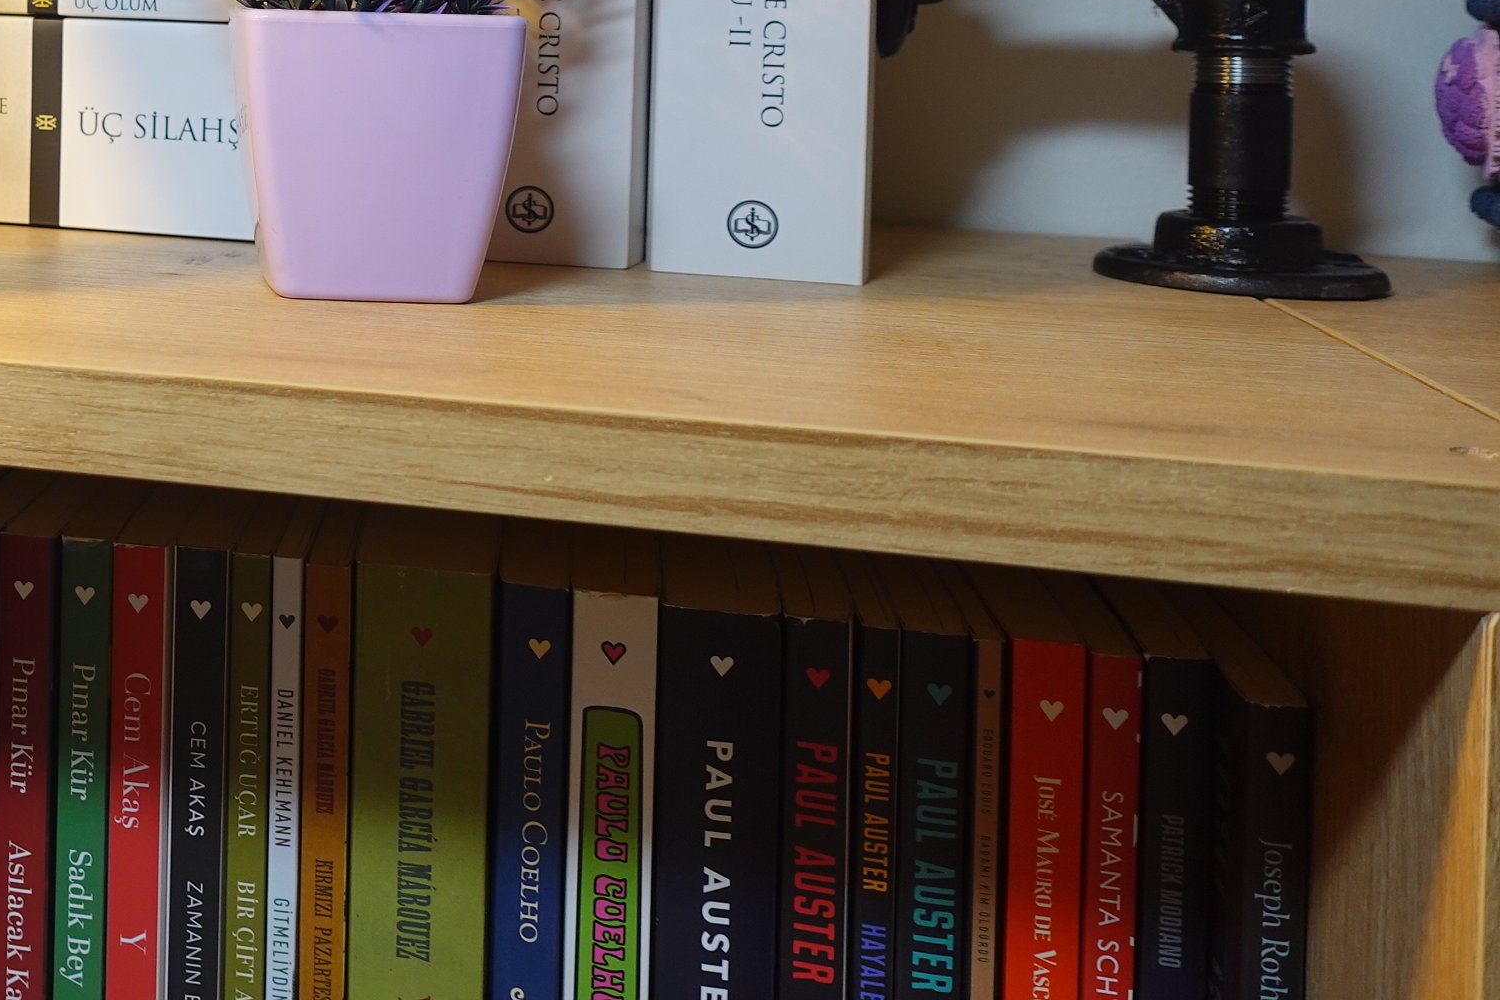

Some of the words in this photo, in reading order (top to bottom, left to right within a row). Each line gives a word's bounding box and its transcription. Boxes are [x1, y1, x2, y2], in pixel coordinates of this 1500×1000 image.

[536, 12, 562, 116] CRISTO
[760, 20, 788, 128] CRISTO
[78, 106, 123, 144] ÜÇ
[10, 656, 36, 737] Pınar
[69, 661, 96, 743] Pınar
[122, 672, 152, 743] Cem
[236, 684, 260, 767] ERTUĞ
[277, 688, 295, 749] DANIEL
[400, 680, 437, 770] GABRIEL
[8, 744, 36, 795] Kür
[68, 748, 95, 802] Kür
[189, 719, 208, 770] CEM
[794, 740, 839, 828] PAUL
[863, 752, 891, 804] PAUL
[113, 751, 151, 831] Akaş
[183, 777, 206, 839] AKAŞ
[233, 773, 258, 839] UÇAR
[273, 756, 294, 849] KEHLMANN
[398, 776, 439, 853] GARCÍA
[595, 742, 632, 864] PAULO
[703, 739, 735, 848] PAUL
[914, 757, 959, 844] PAUL
[65, 848, 95, 930] Sadık
[314, 858, 334, 919] KIRMIZI
[861, 813, 890, 894] AUSTER
[1098, 790, 1124, 927] SAMANTA
[1160, 813, 1185, 885] PATRICK
[1253, 837, 1294, 929] Joseph
[4, 839, 34, 961] Asılacak
[184, 880, 205, 985] ZAMANIN
[235, 879, 258, 920] BİR
[395, 860, 437, 964] MÁRQUEZ
[791, 845, 837, 986] AUSTER
[911, 859, 956, 996] AUSTER
[1157, 889, 1184, 969] MODIANO
[58, 937, 93, 990] Bey
[118, 928, 148, 957] Y
[232, 924, 258, 984] ÇİFT
[1095, 938, 1121, 1000] SCH
